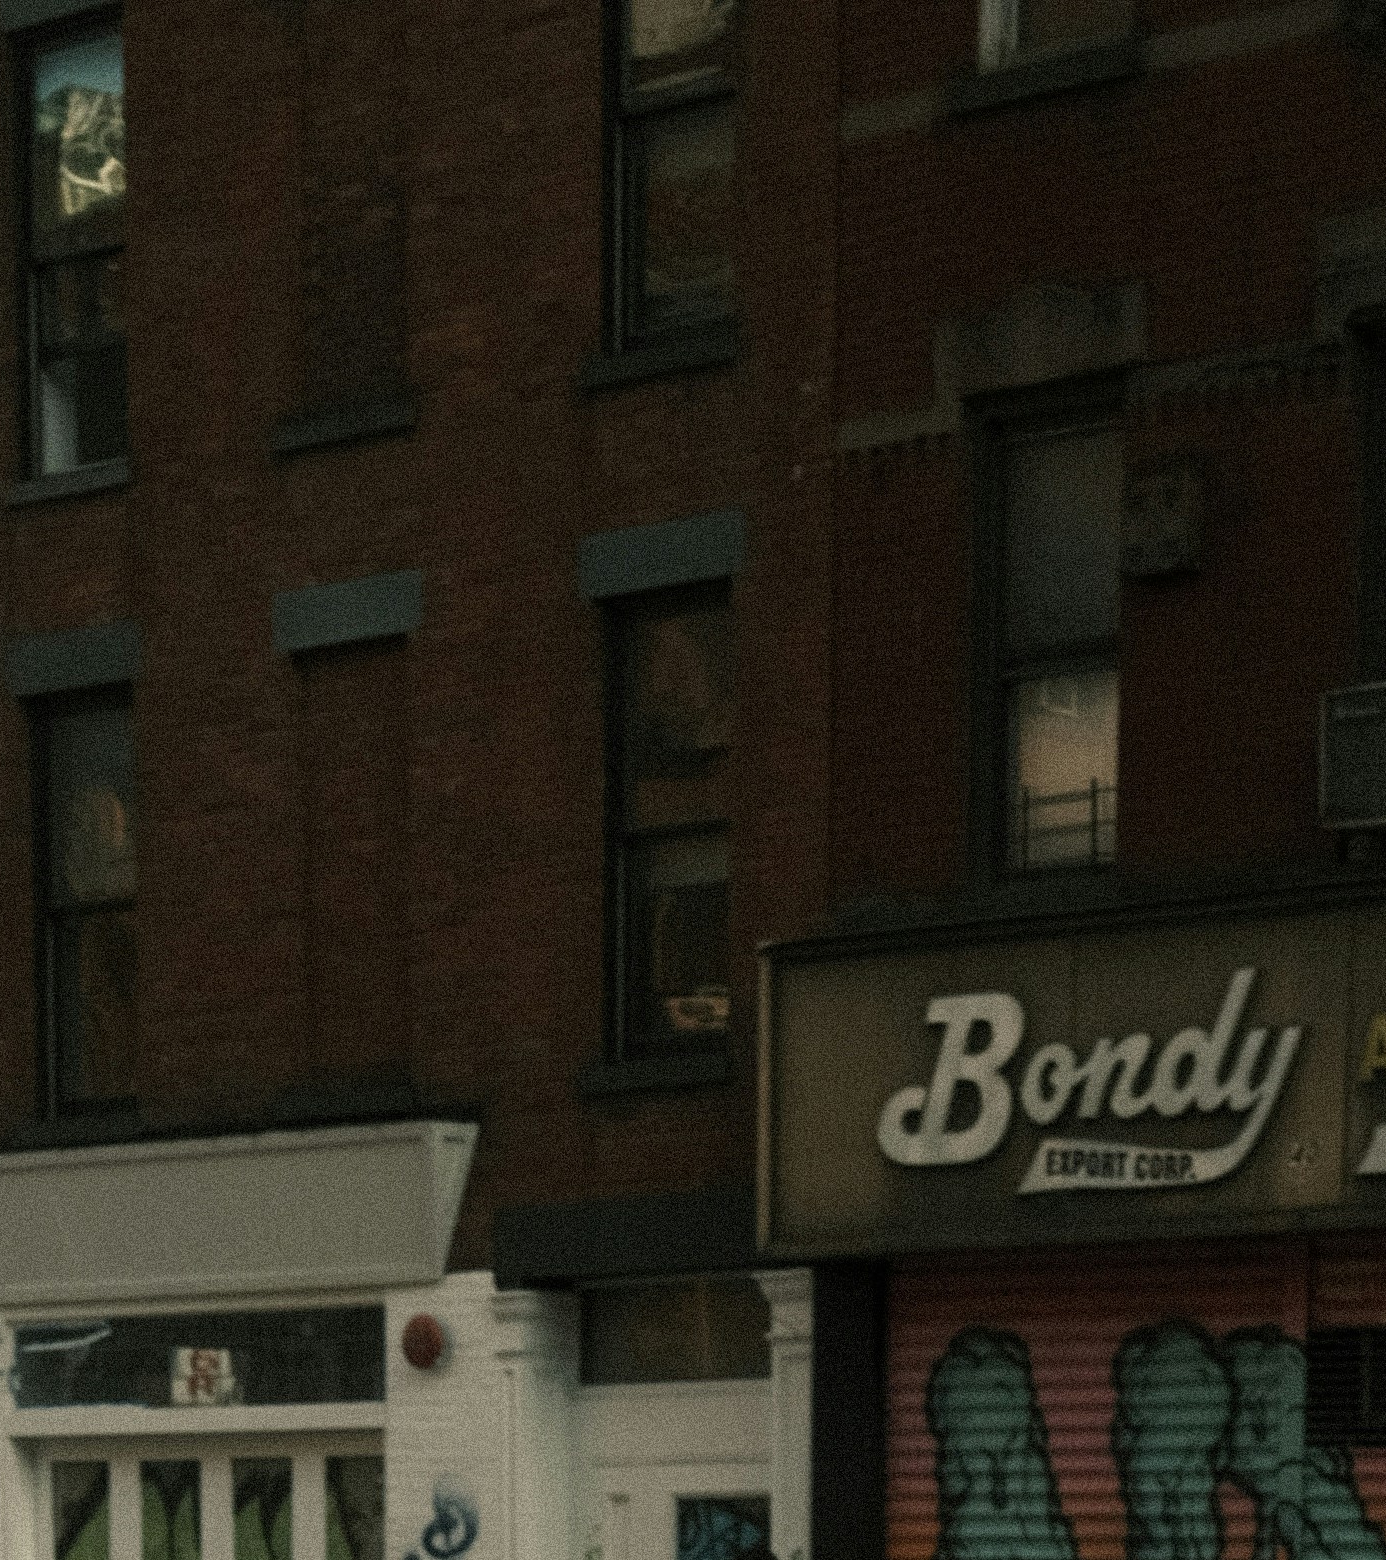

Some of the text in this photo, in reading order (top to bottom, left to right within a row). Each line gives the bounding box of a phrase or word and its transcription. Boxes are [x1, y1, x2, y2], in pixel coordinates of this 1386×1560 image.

[877, 967, 1303, 1168] Bondy
[1044, 1148, 1196, 1184] EXPORT CORP.
